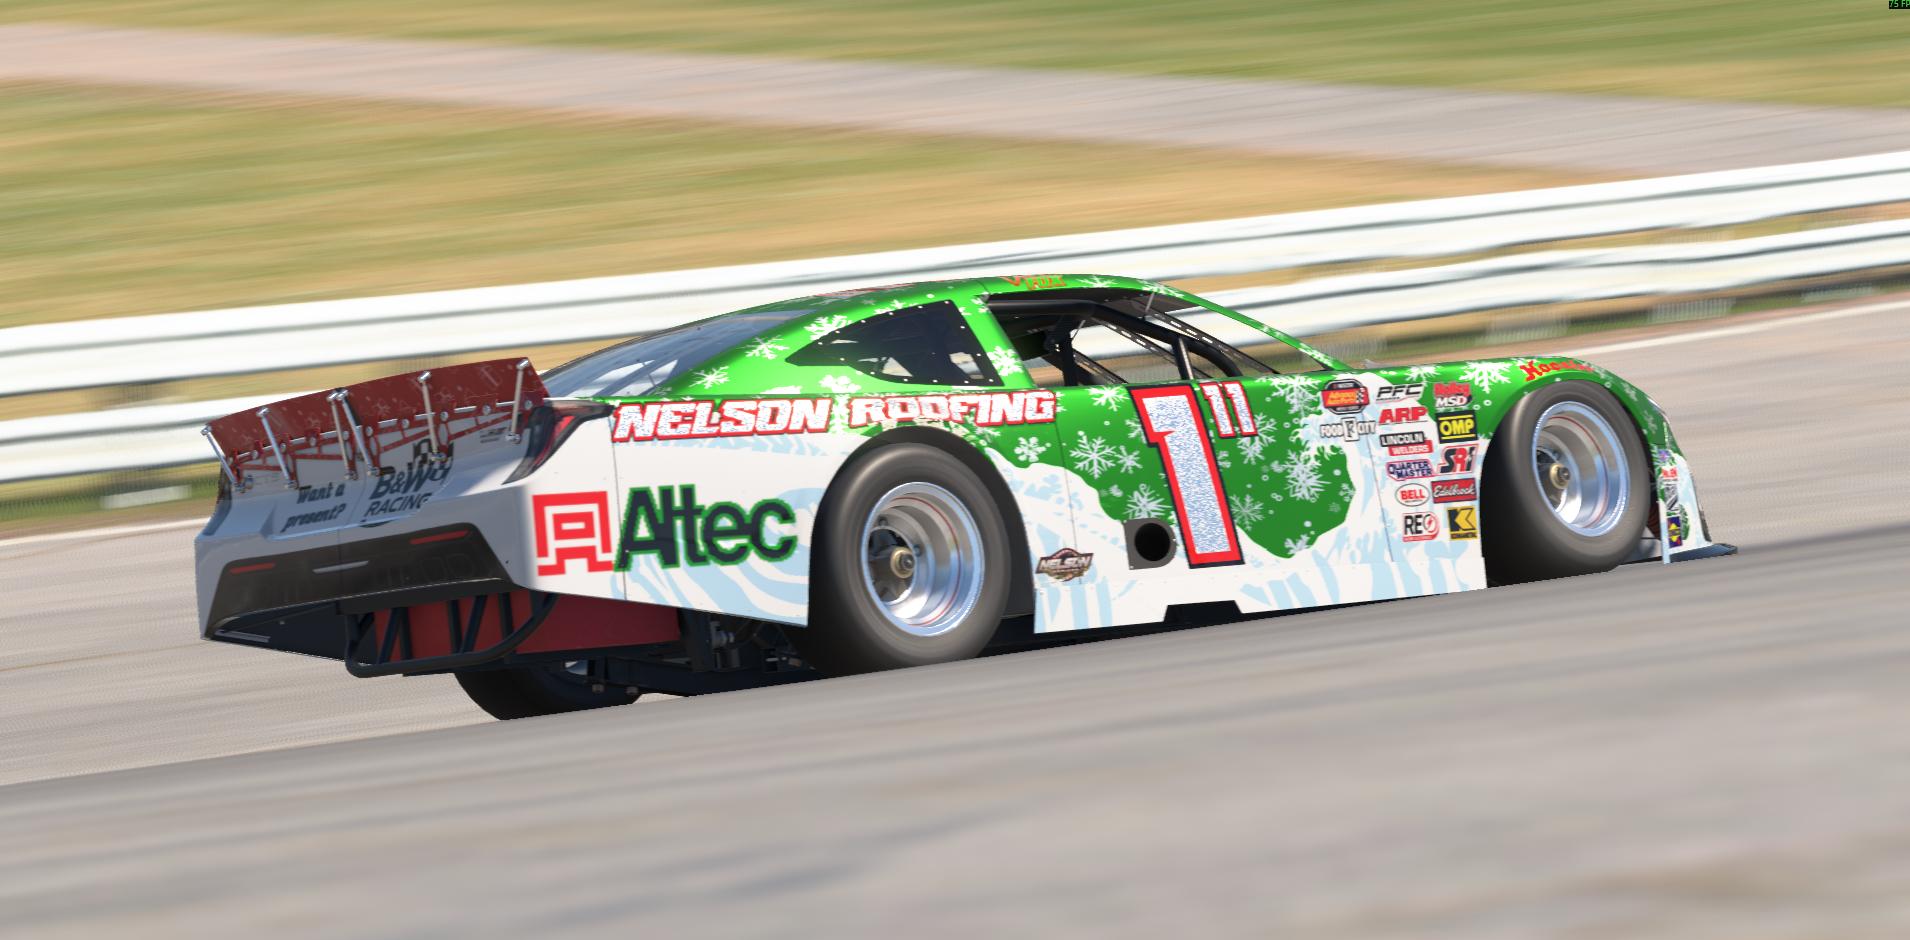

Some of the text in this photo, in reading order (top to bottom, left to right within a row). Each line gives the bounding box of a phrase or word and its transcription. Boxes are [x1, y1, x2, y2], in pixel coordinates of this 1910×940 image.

[1377, 384, 1423, 398] PFC
[1199, 379, 1259, 439] 11
[1435, 396, 1469, 409] MSD
[611, 391, 1057, 442] NELSON ROOFING
[1379, 407, 1428, 425] ARP
[1320, 420, 1377, 437] FOOD CITY
[1440, 419, 1474, 435] OMP
[1381, 432, 1424, 445] LINCOLN
[1391, 445, 1431, 455] WELDERS
[370, 460, 430, 500] B&W
[1126, 383, 1245, 569] 1
[1395, 468, 1433, 479] MASTER
[296, 482, 345, 504] Want a
[1400, 489, 1425, 500] BELL
[364, 493, 432, 517] RACING
[280, 503, 347, 533] present?
[614, 483, 798, 572] Altec
[1038, 556, 1093, 571] NELSON
